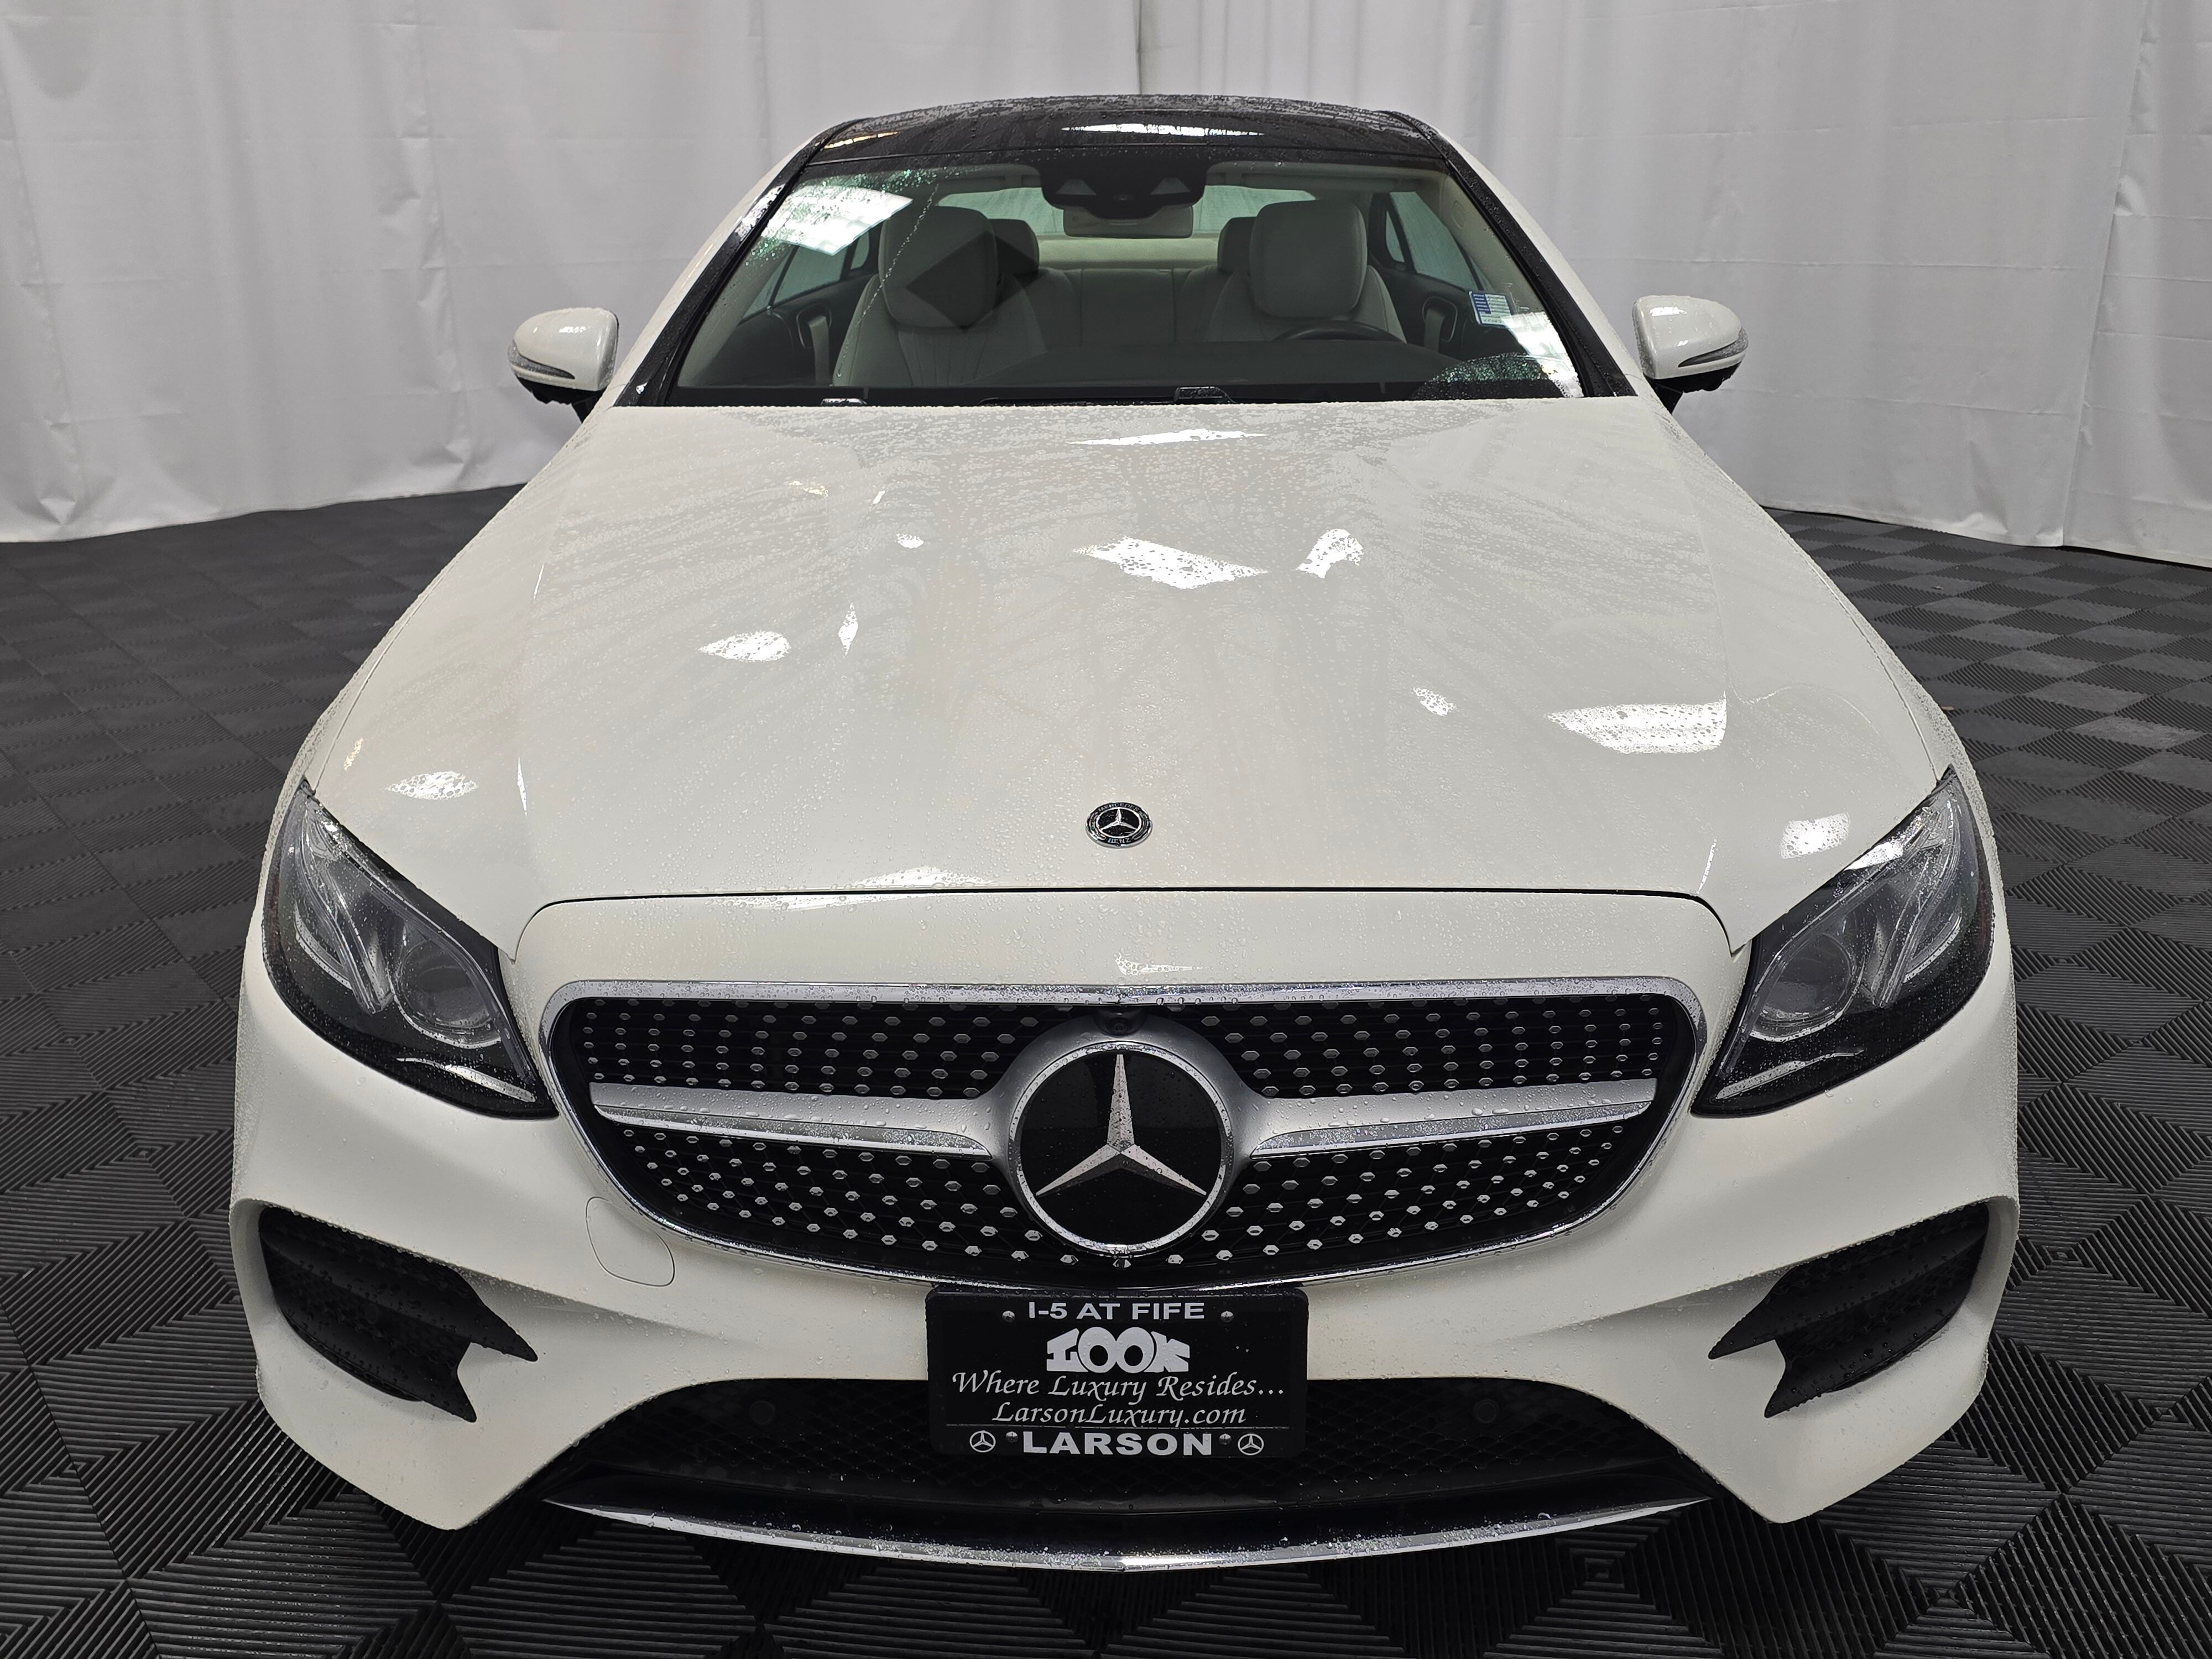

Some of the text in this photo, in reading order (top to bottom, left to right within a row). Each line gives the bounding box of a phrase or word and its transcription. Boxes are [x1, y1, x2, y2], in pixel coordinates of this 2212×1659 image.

[1029, 1302, 1204, 1320] I-5 AT FIFE
[1046, 1327, 1190, 1374] LOOK
[952, 1369, 1284, 1405] Where Luxury Resides...
[992, 1401, 1246, 1428] LarsonLuxury.com
[1022, 1431, 1212, 1455] LARSON
